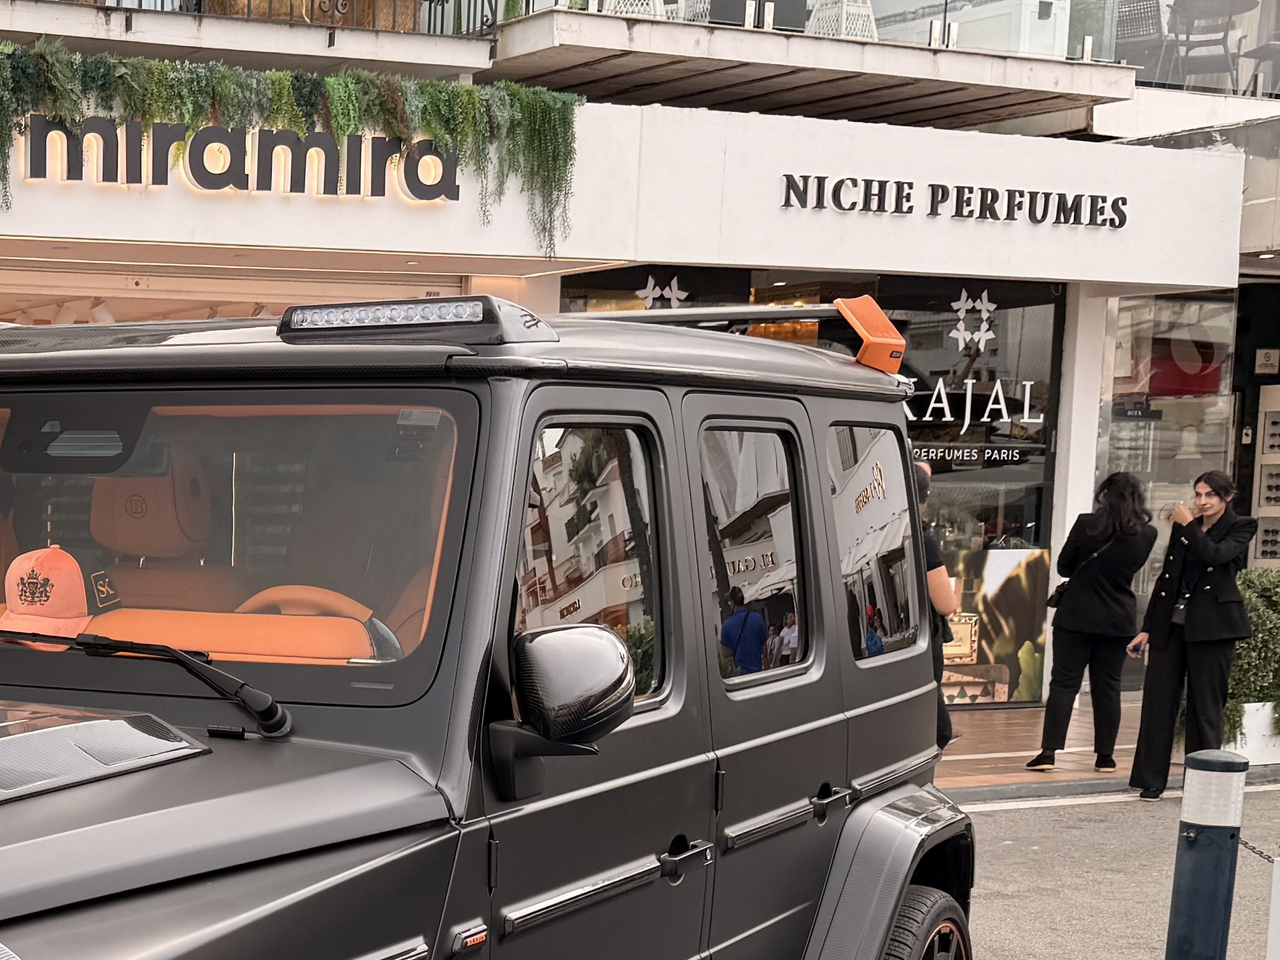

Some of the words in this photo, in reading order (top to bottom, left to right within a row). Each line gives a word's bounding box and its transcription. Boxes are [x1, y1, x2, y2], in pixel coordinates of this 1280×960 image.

[24, 113, 461, 202] miramira
[780, 173, 915, 215] NICHE
[926, 183, 1129, 230] PERFUMES
[913, 448, 979, 461] PERFUMES
[984, 449, 1021, 461] PARIS
[96, 577, 116, 599] SK
